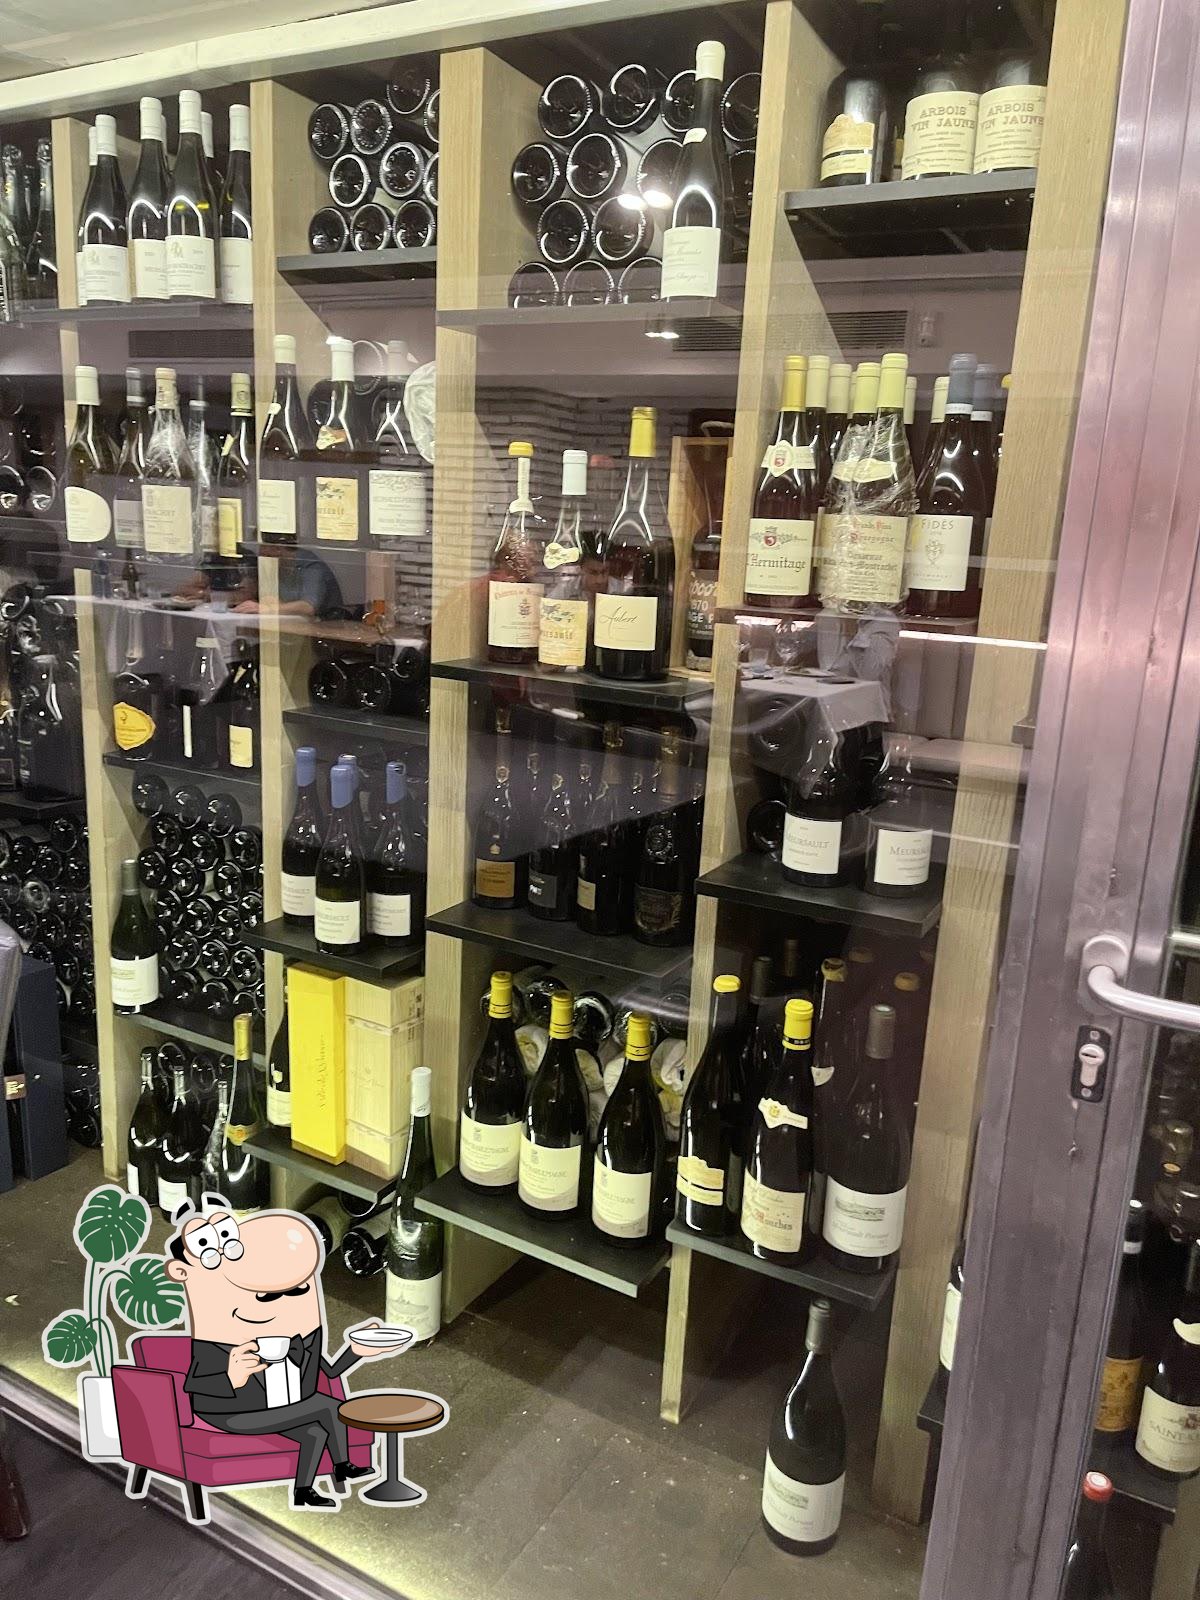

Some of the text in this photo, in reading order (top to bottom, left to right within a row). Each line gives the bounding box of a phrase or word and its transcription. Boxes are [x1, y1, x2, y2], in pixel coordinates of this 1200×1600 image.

[919, 105, 967, 119] ARBOIS
[987, 102, 1034, 117] ARBOIS
[911, 117, 976, 132] VIN JAUNE
[1002, 114, 1044, 126] JAUNE
[921, 518, 955, 530] FIDES
